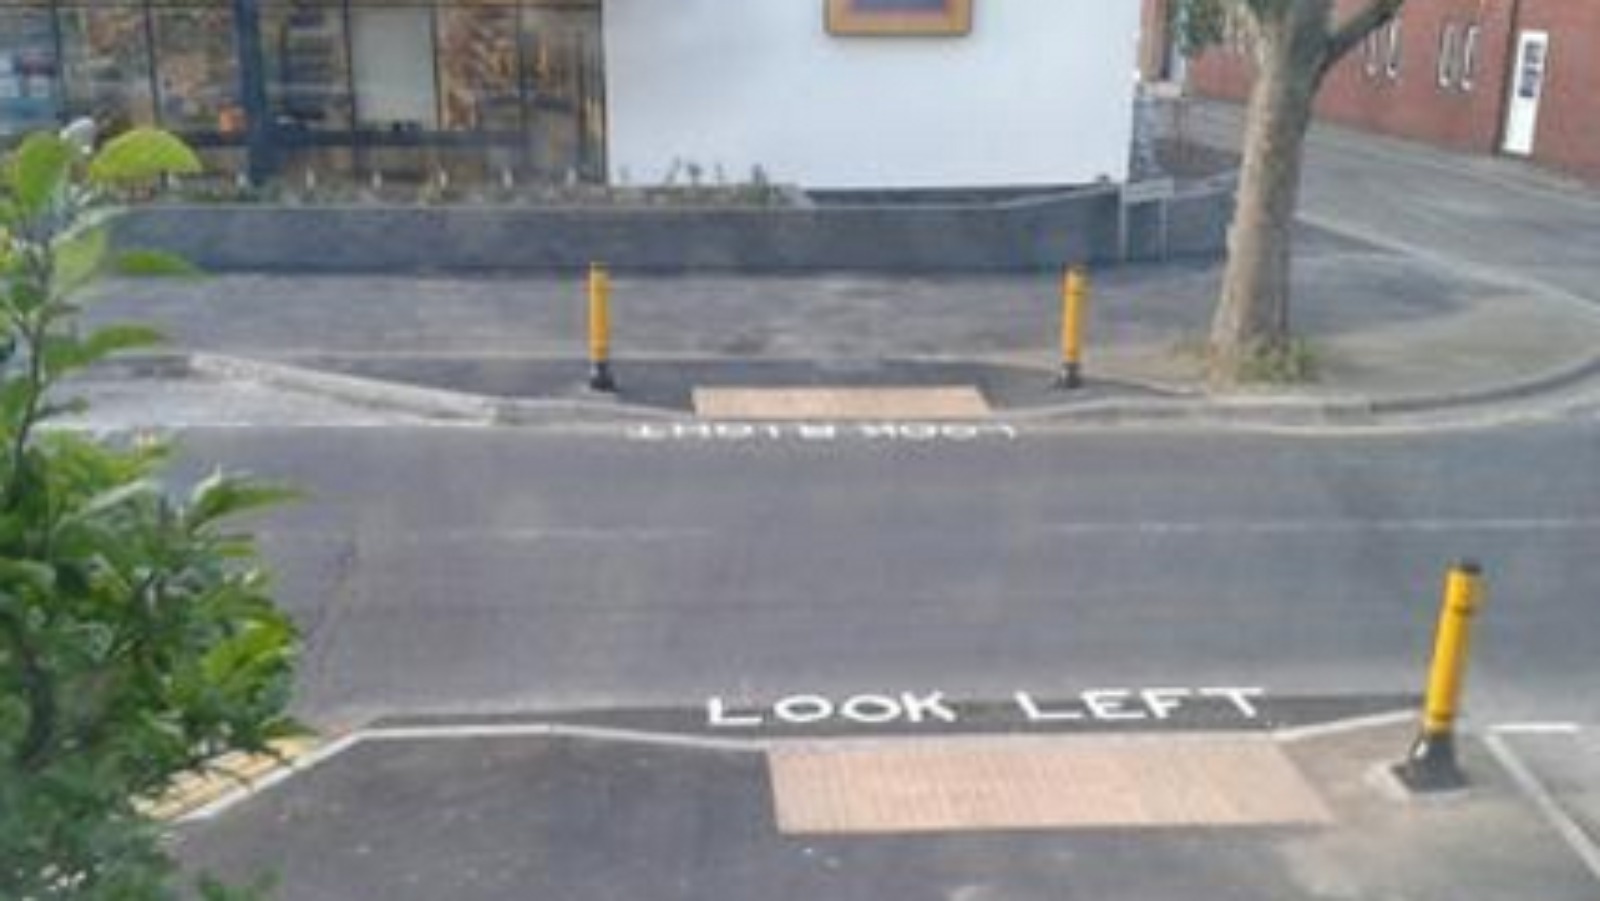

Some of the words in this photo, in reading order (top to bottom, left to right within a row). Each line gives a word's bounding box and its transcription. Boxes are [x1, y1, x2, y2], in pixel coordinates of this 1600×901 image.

[862, 422, 1017, 439] LOOK
[706, 691, 957, 727] LOOK
[1014, 686, 1267, 721] LEFT
